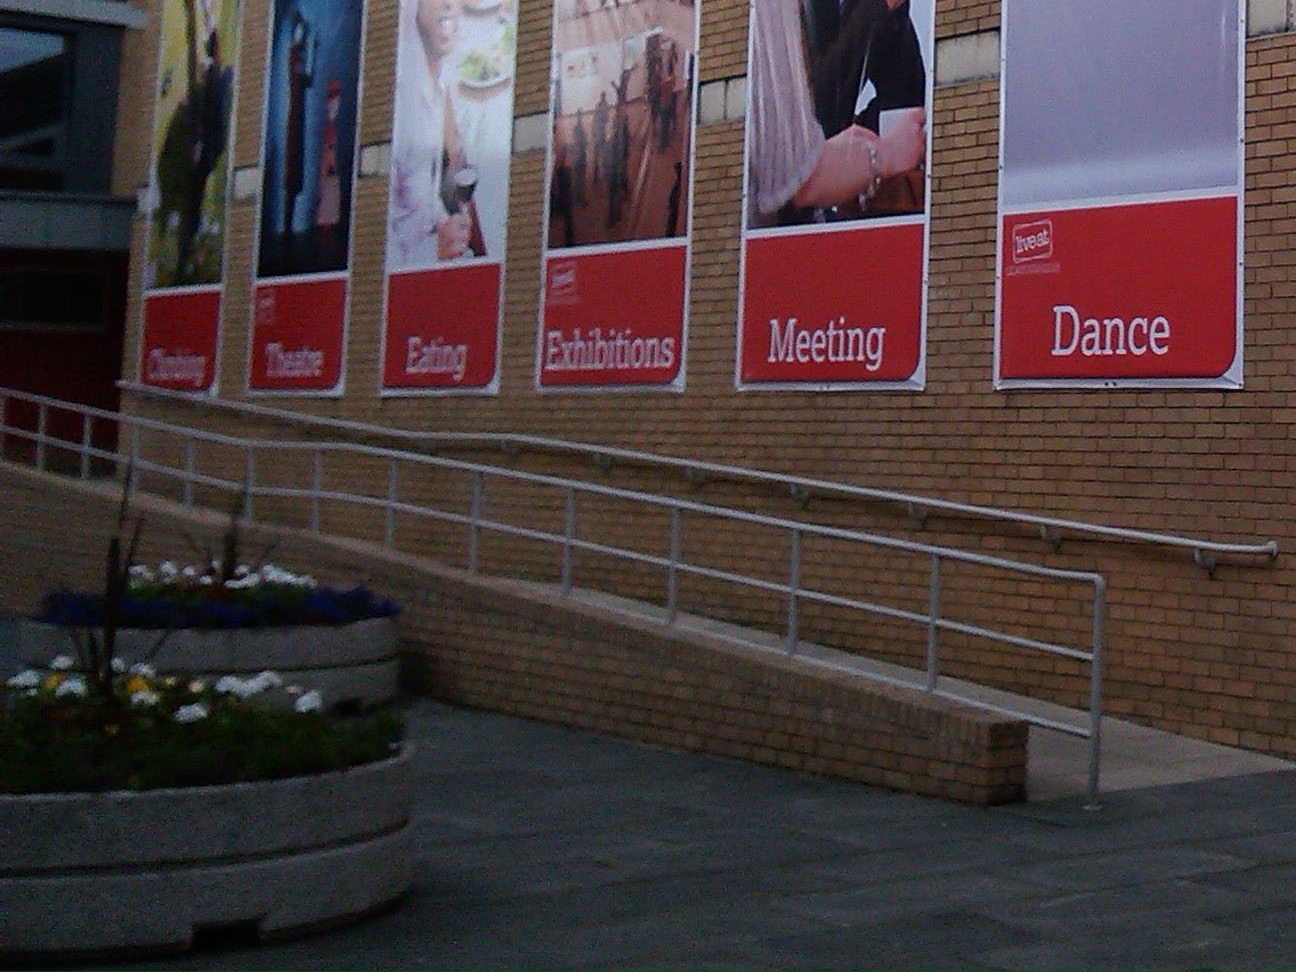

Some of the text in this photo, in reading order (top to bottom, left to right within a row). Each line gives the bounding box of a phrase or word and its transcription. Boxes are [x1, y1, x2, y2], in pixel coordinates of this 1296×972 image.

[544, 328, 675, 371] Exhibitions
[766, 316, 886, 372] Meeting
[1051, 304, 1171, 357] Dance
[405, 334, 467, 382] Eating
